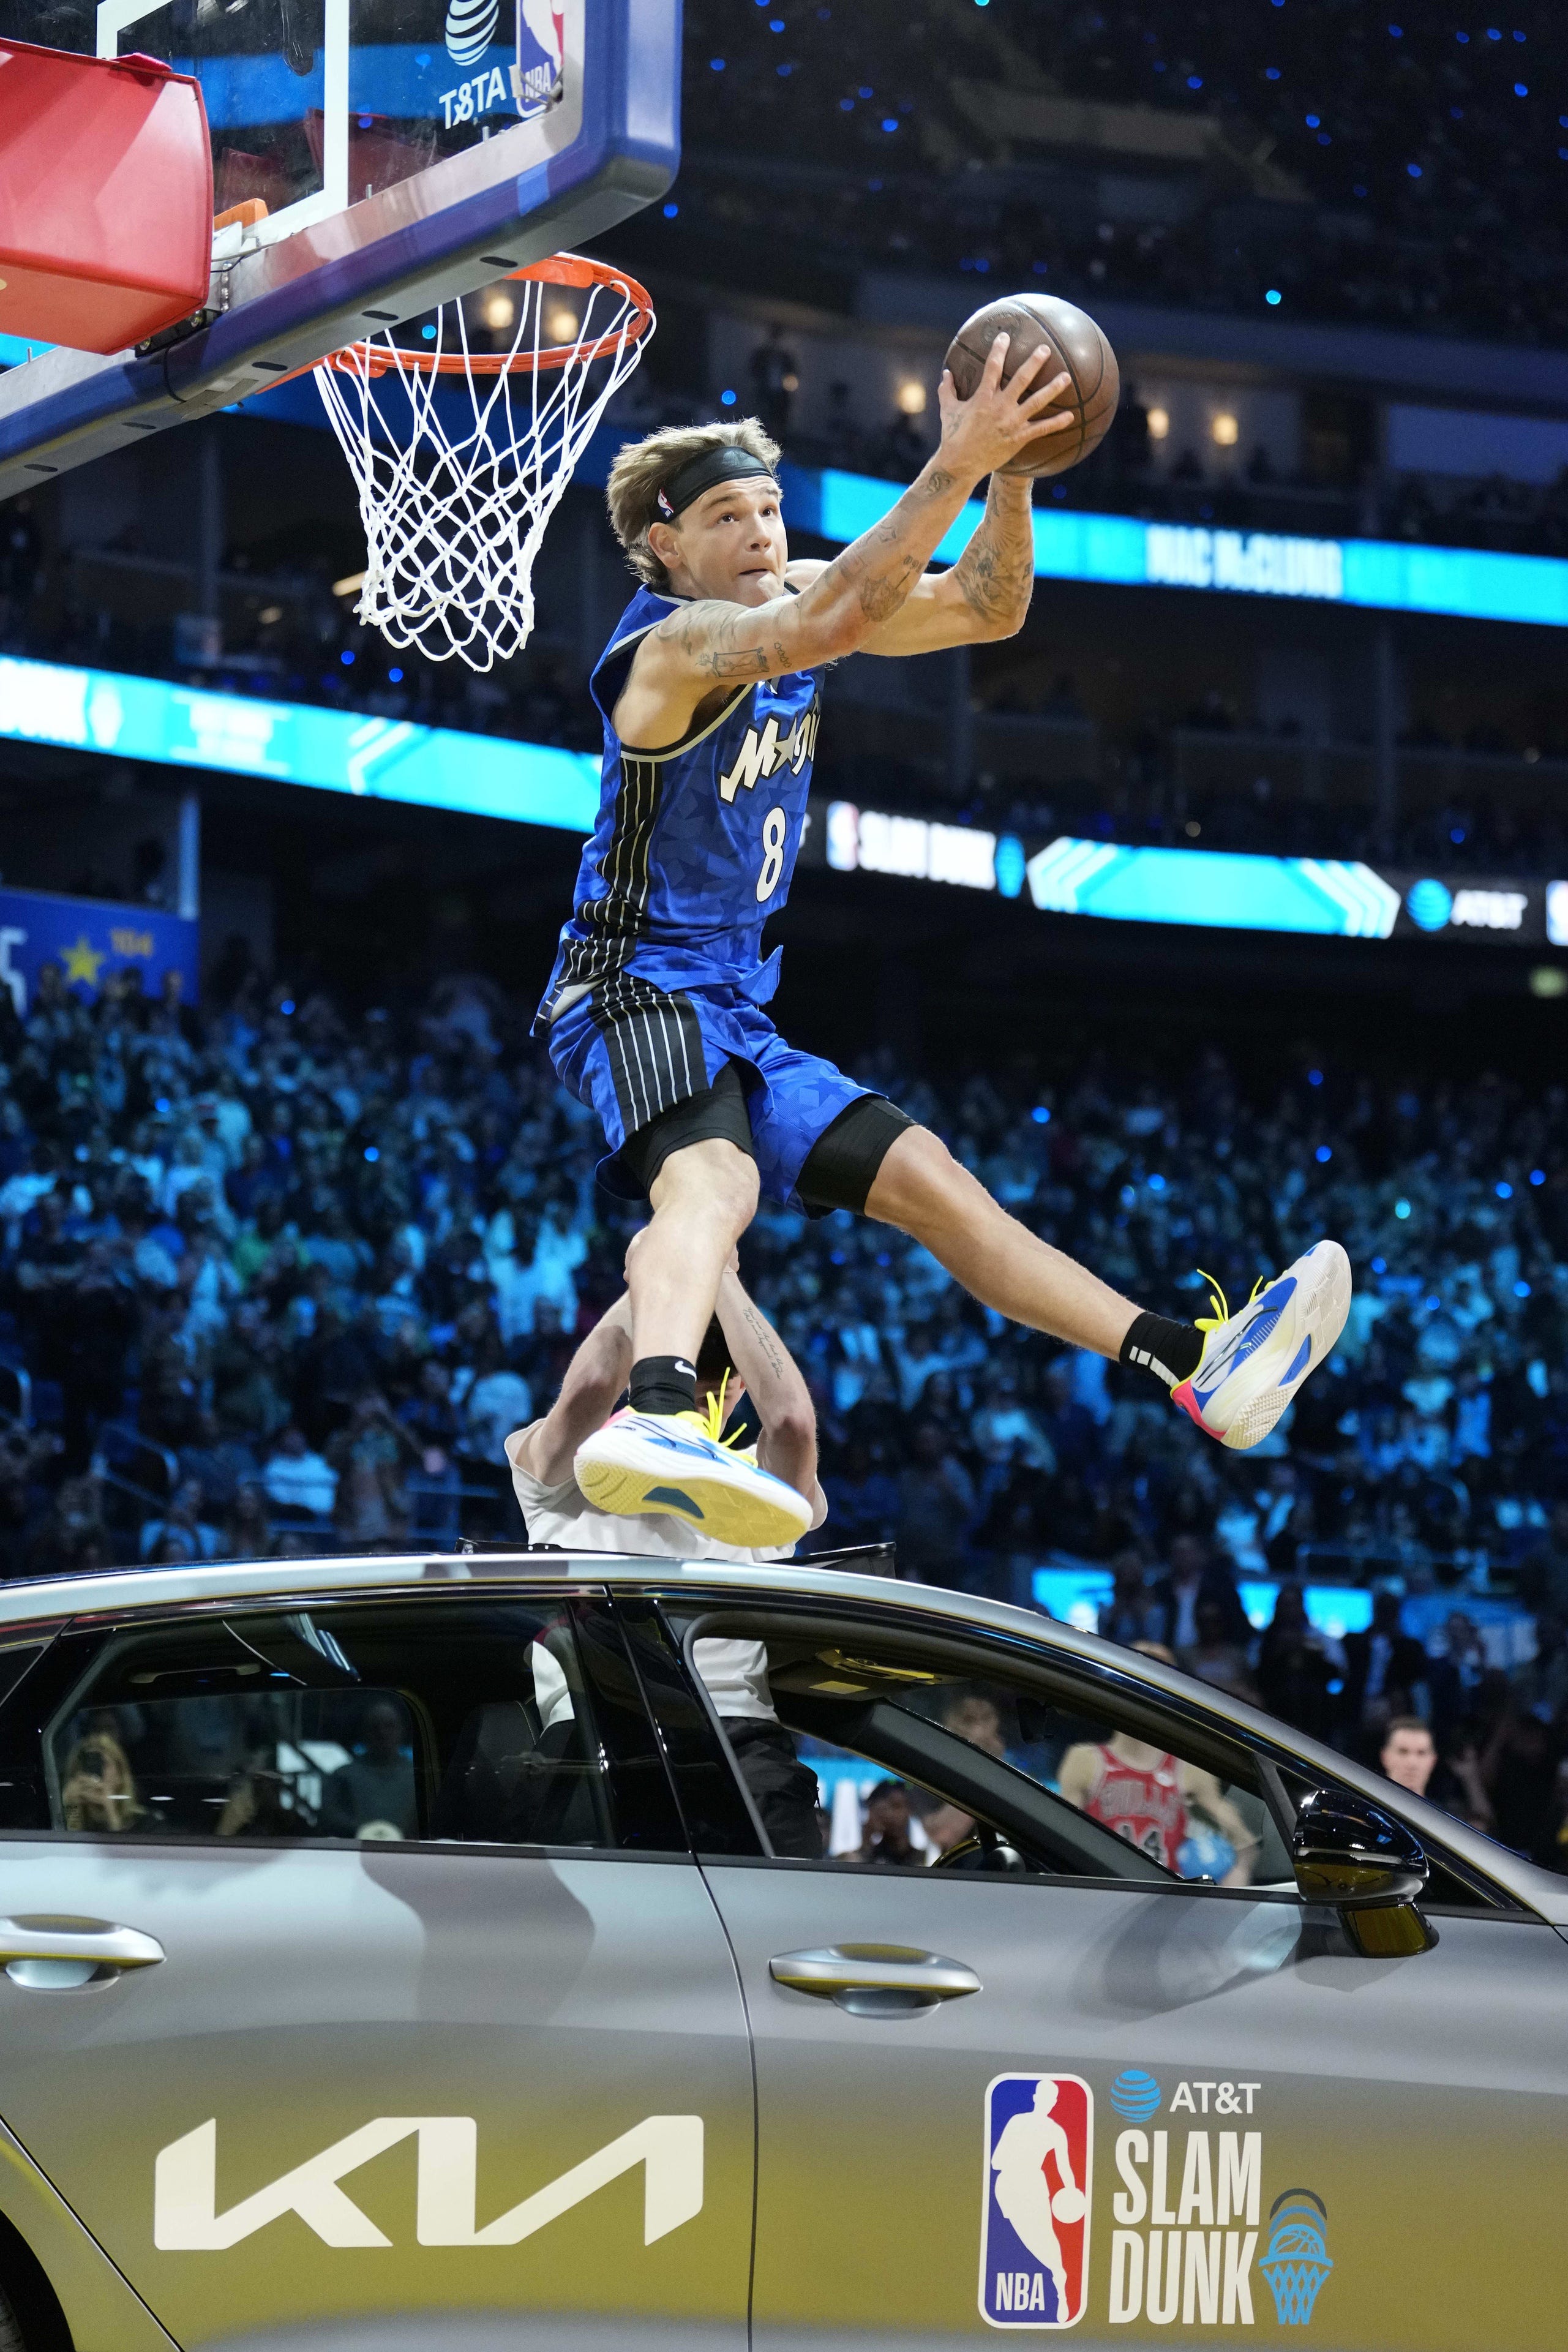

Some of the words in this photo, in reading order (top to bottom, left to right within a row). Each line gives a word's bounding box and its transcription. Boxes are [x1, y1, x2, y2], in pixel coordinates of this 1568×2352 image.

[525, 61, 552, 103] NBA
[756, 806, 787, 903] 8
[1169, 2082, 1262, 2114] AT&T
[154, 2115, 704, 2250] KIA
[1112, 2128, 1262, 2226] SLAM
[995, 2272, 1045, 2312] NBA
[1108, 2230, 1259, 2325] DUNK
